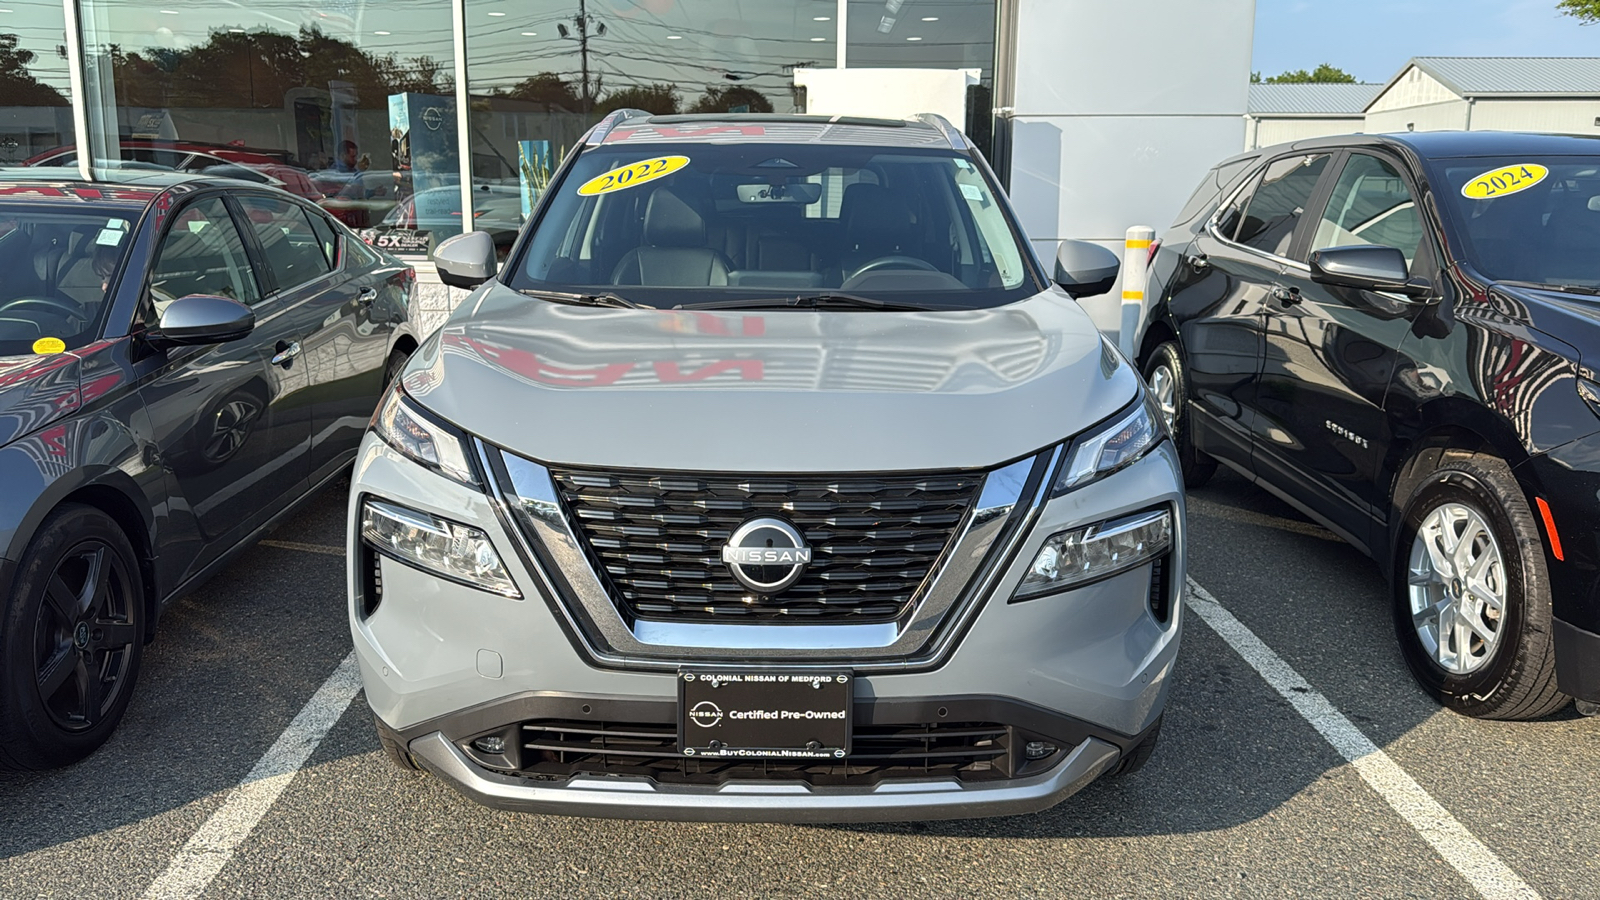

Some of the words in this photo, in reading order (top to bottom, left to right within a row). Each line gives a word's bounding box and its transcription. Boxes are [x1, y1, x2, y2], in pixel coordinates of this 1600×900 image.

[599, 159, 668, 191] 2022
[1476, 166, 1534, 195] 2024
[377, 235, 402, 247] 5X
[725, 550, 809, 562] NISSAN
[700, 674, 743, 682] COLONIAL
[791, 675, 832, 683] MEDFORD
[729, 710, 779, 720] Certified
[780, 710, 846, 720] Pre-Owned
